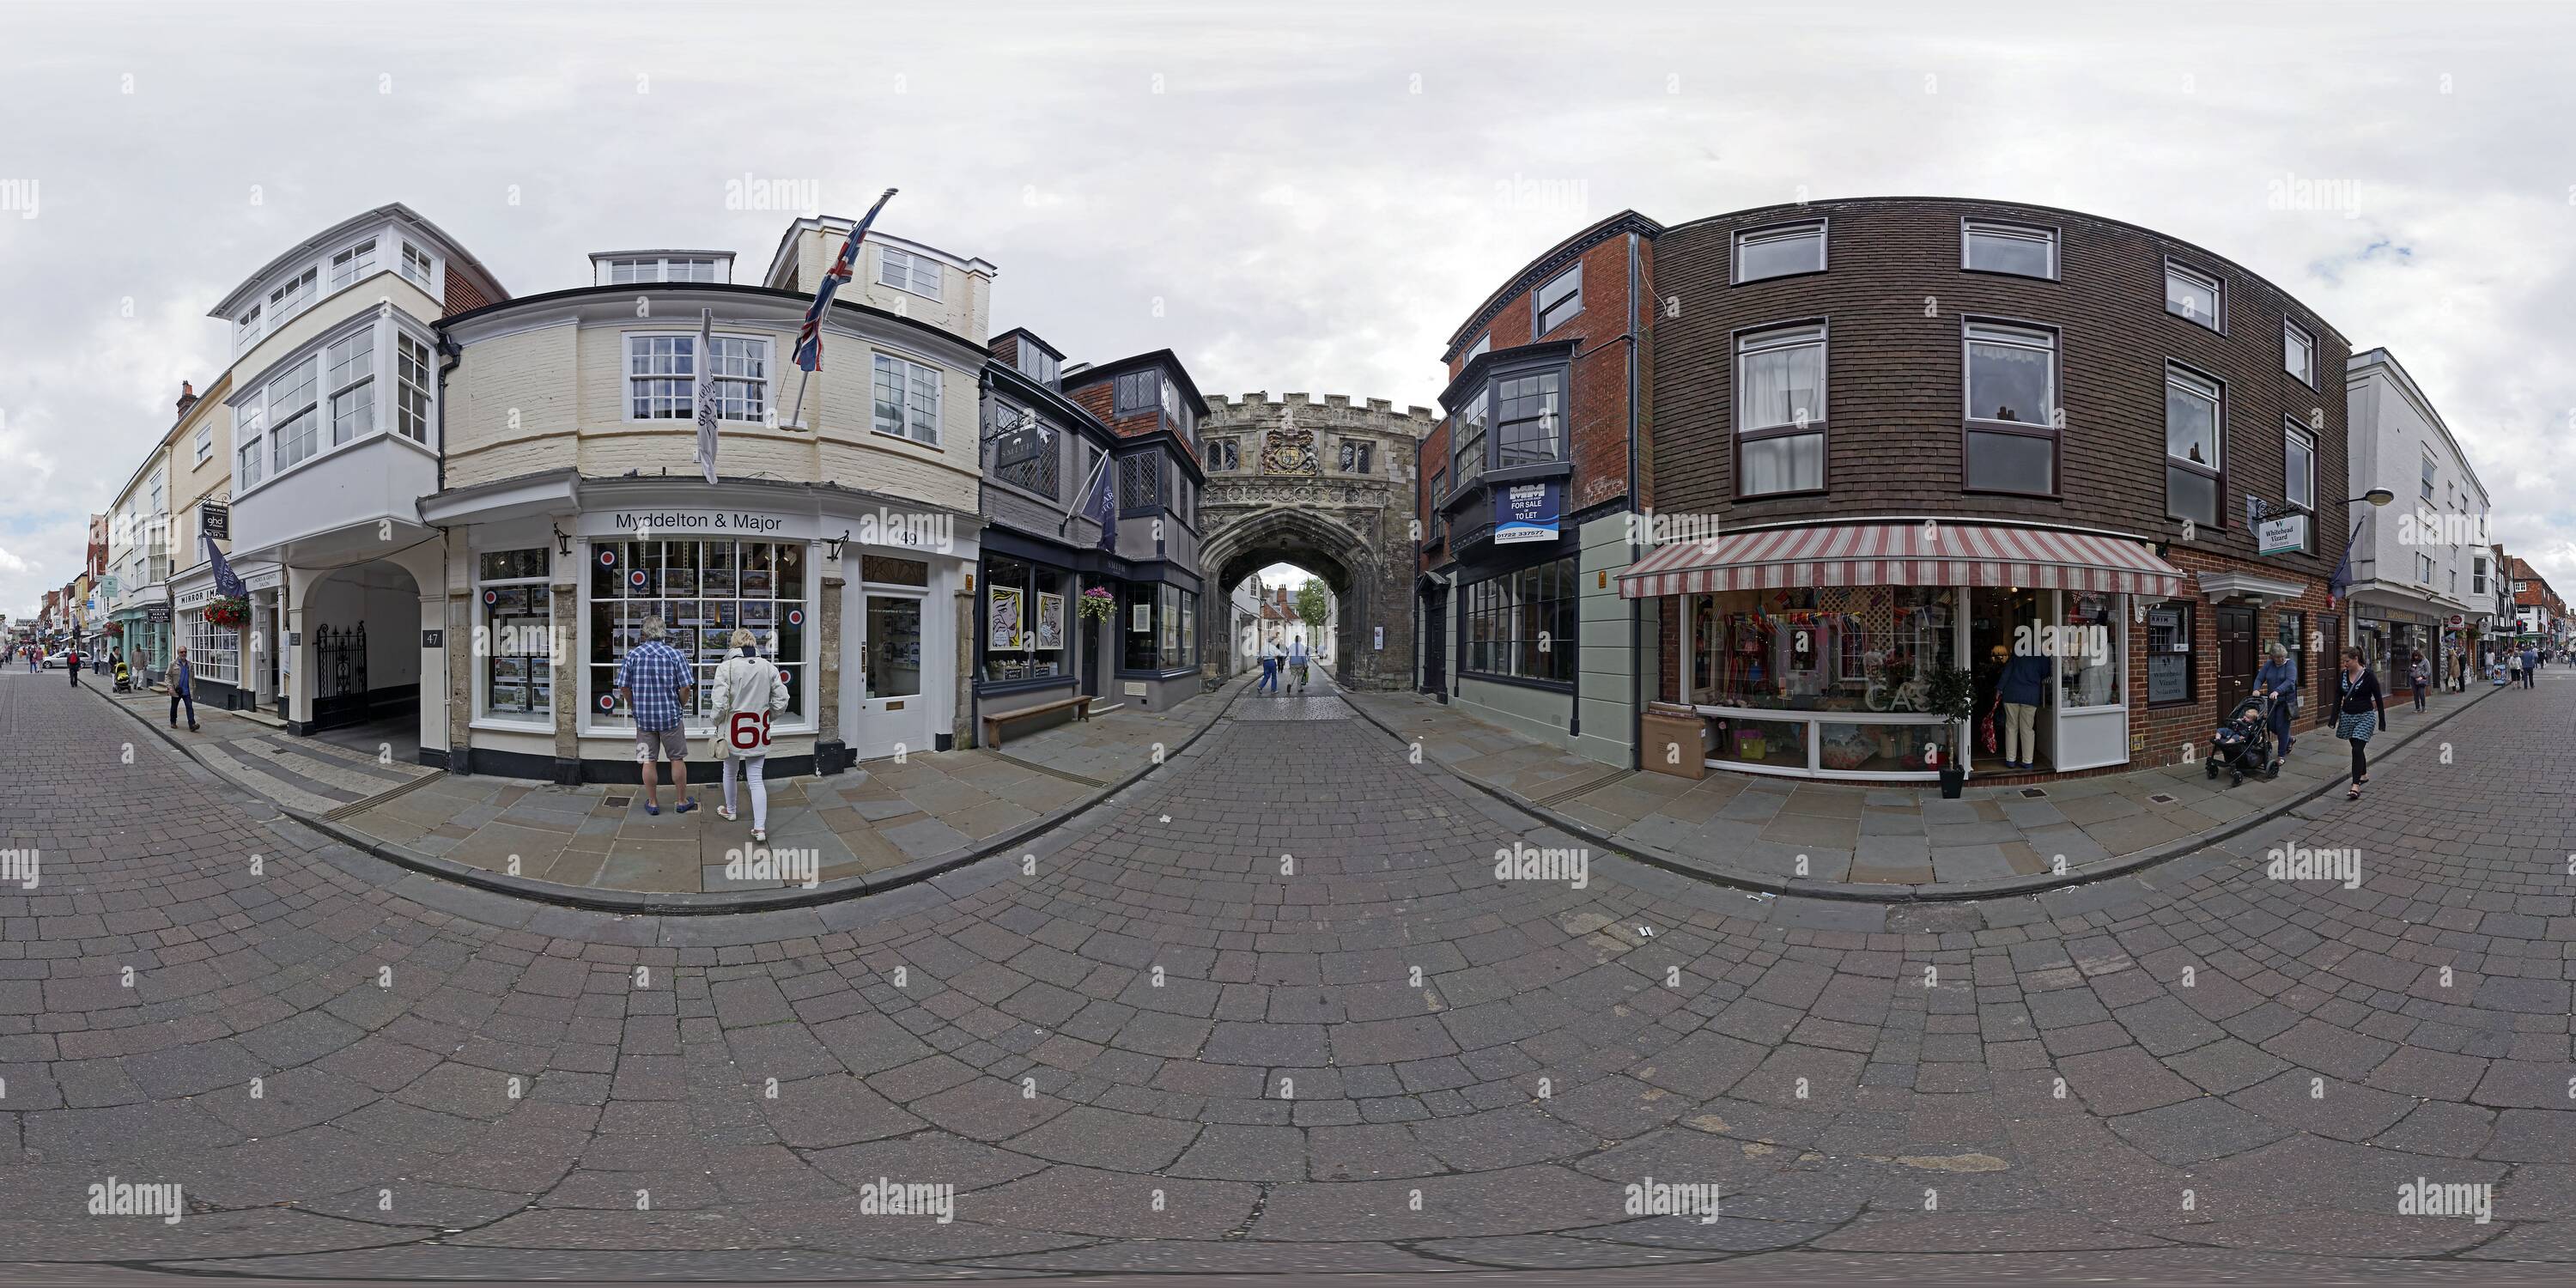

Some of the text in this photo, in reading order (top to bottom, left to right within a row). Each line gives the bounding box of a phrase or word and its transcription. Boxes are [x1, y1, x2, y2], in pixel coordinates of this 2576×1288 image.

[1001, 442, 1033, 458] SMITH
[1525, 500, 1542, 508] SALE
[1525, 511, 1537, 519] LET
[616, 513, 782, 532] Myddelton & Major
[2266, 526, 2293, 537] Whitehead
[901, 532, 917, 546] 49
[2271, 533, 2288, 542] Vizard
[1106, 562, 1127, 573] SMITH
[181, 588, 220, 604] MIRROR IMA
[427, 634, 438, 645] 47
